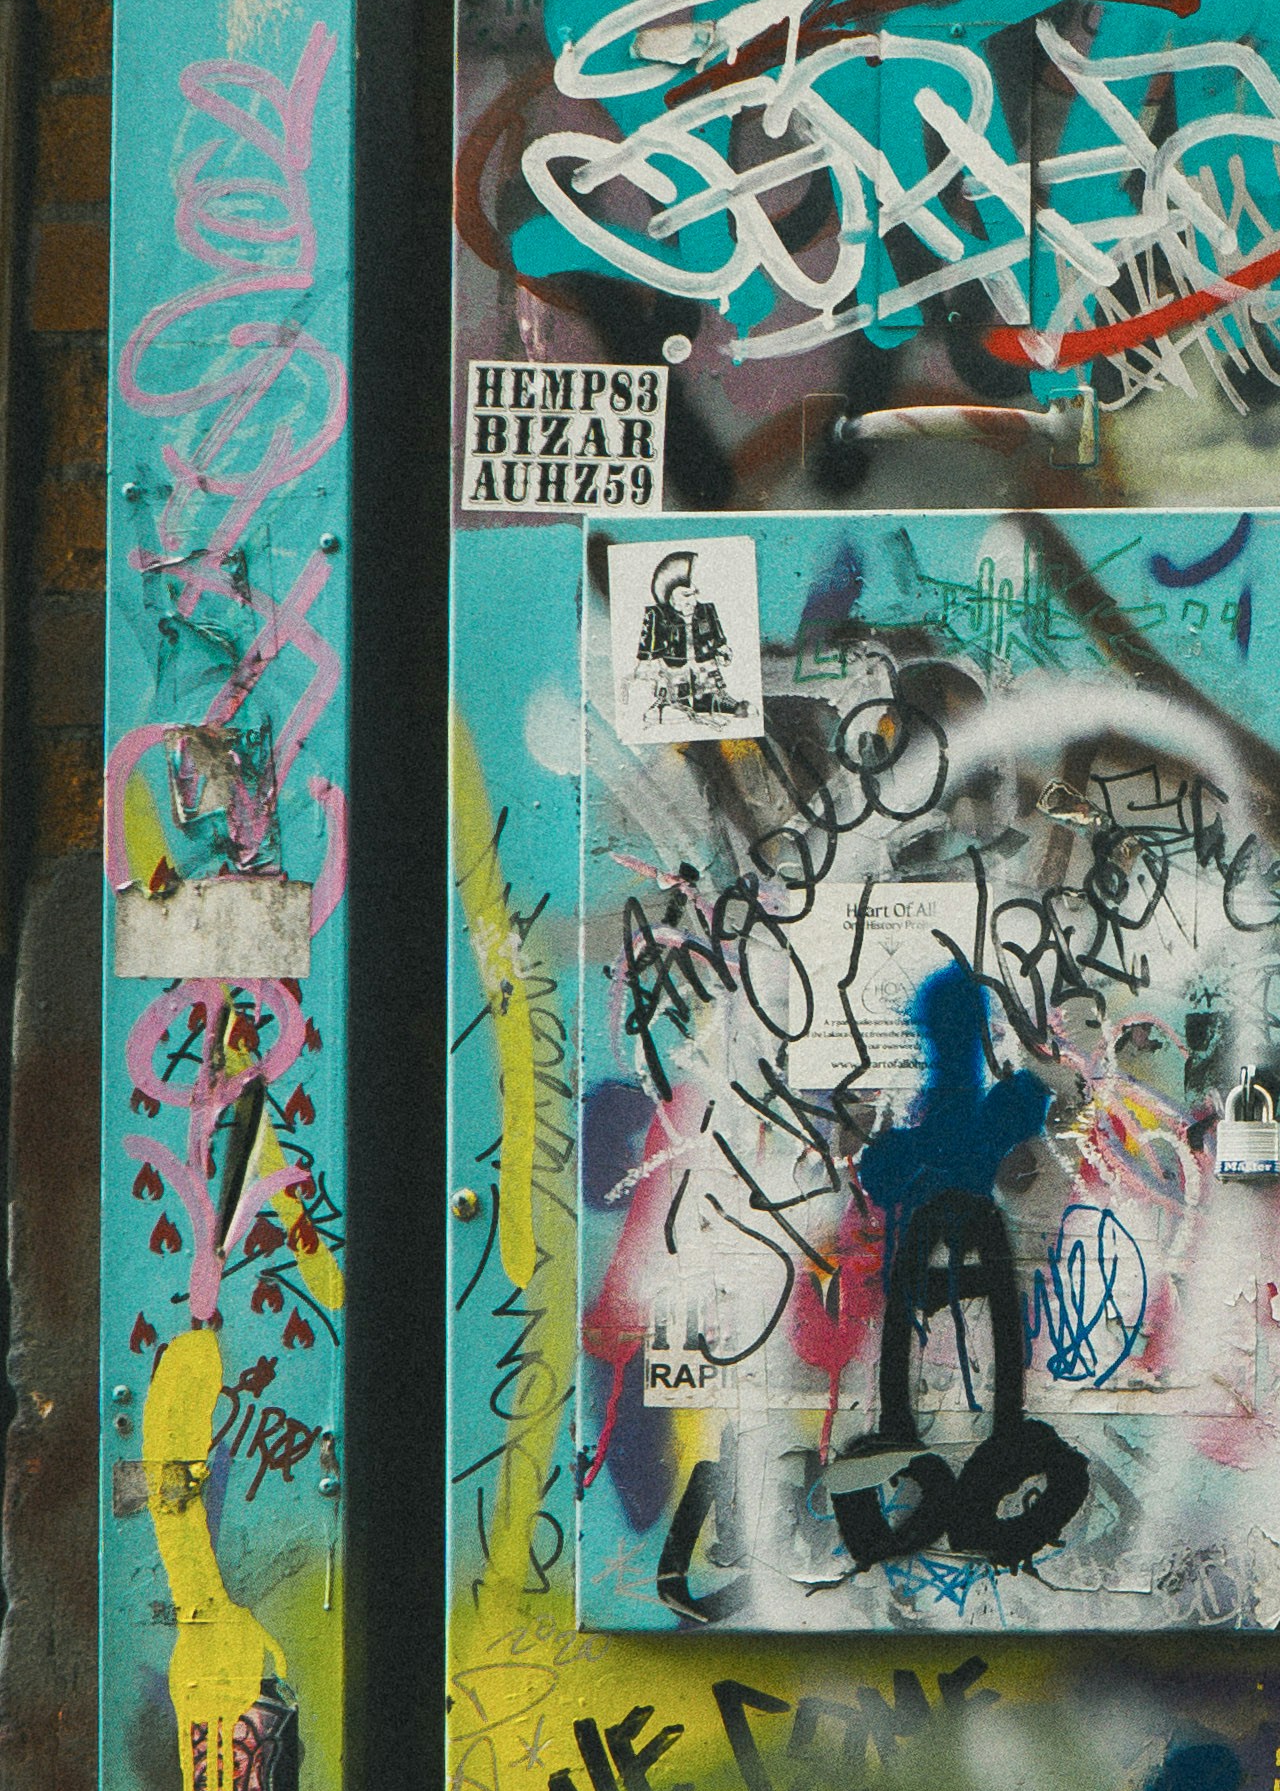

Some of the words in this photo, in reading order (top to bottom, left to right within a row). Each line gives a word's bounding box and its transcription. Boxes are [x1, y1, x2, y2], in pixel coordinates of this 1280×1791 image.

[474, 367, 661, 416] HEMP83
[471, 415, 659, 461] BIZAR
[469, 460, 654, 507] AUHZ59
[846, 902, 889, 918] Hart
[893, 902, 913, 918] Of
